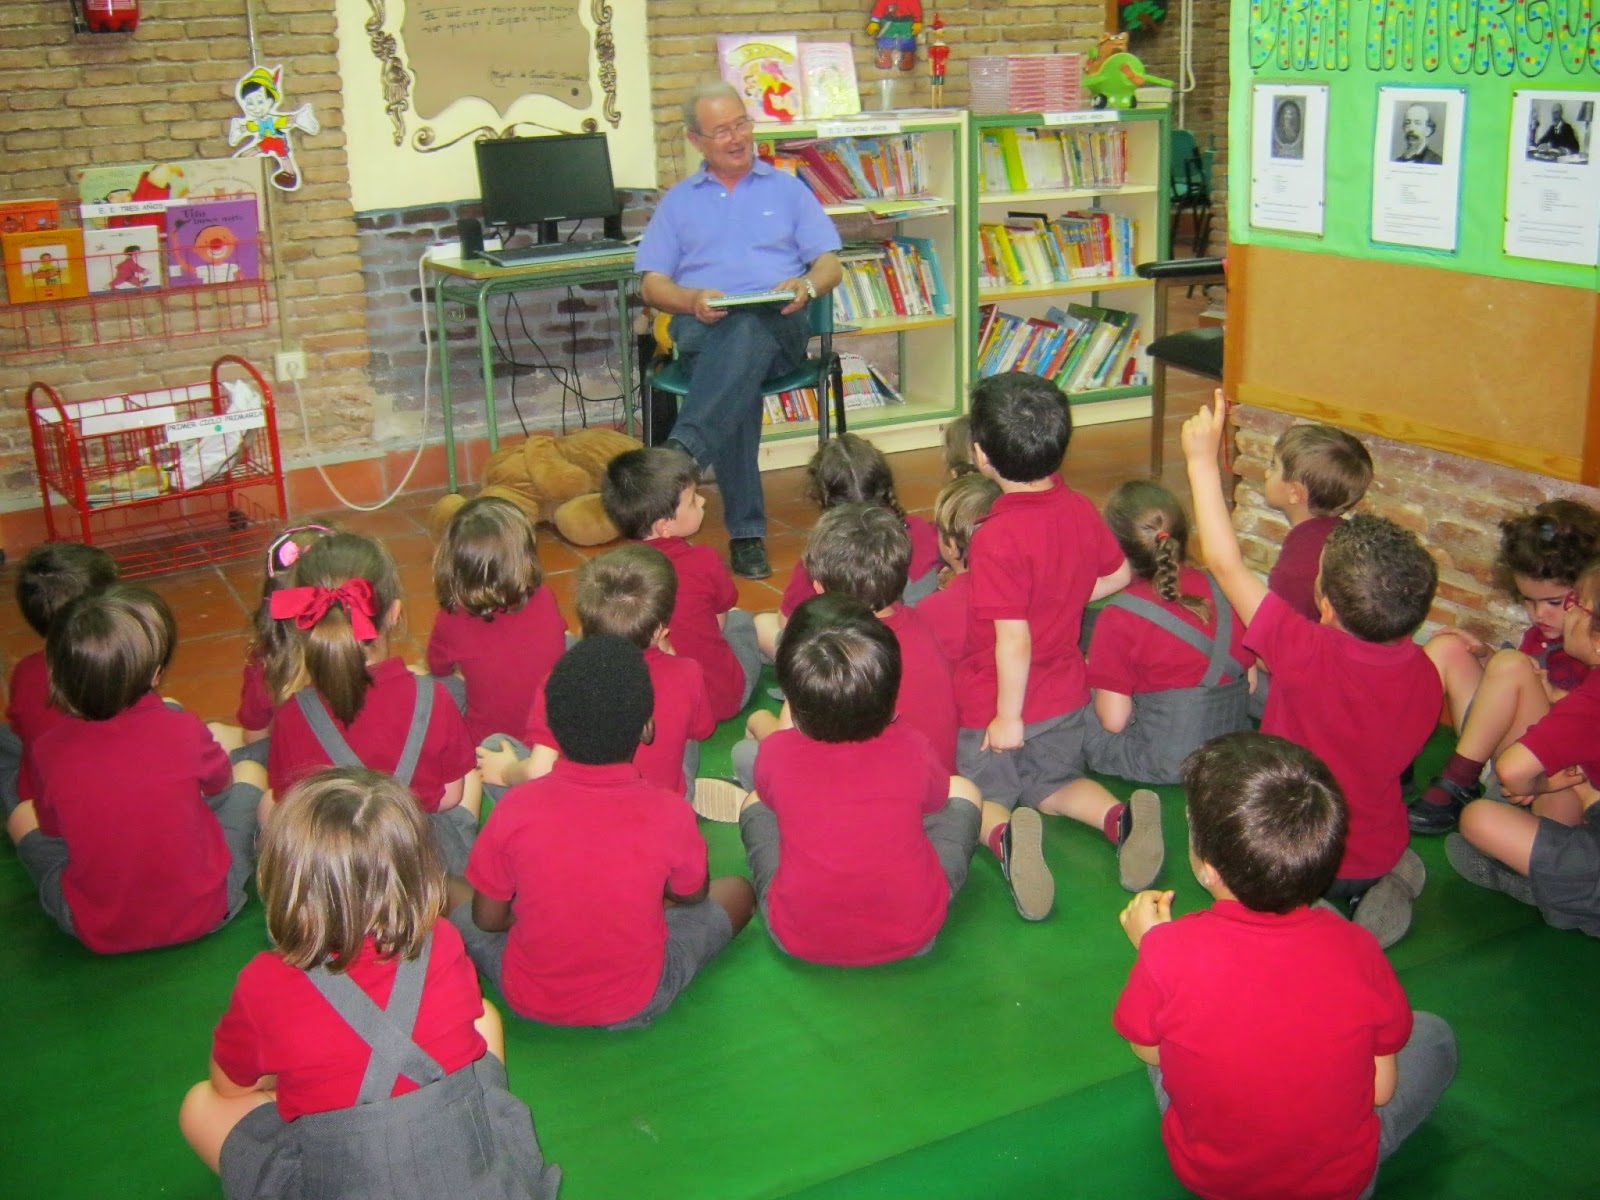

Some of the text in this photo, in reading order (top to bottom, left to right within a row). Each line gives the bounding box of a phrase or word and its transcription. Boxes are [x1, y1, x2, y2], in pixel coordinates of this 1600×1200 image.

[142, 202, 164, 210] AÑOS
[167, 411, 263, 431] PRIMER CICLO PRIMARIA
